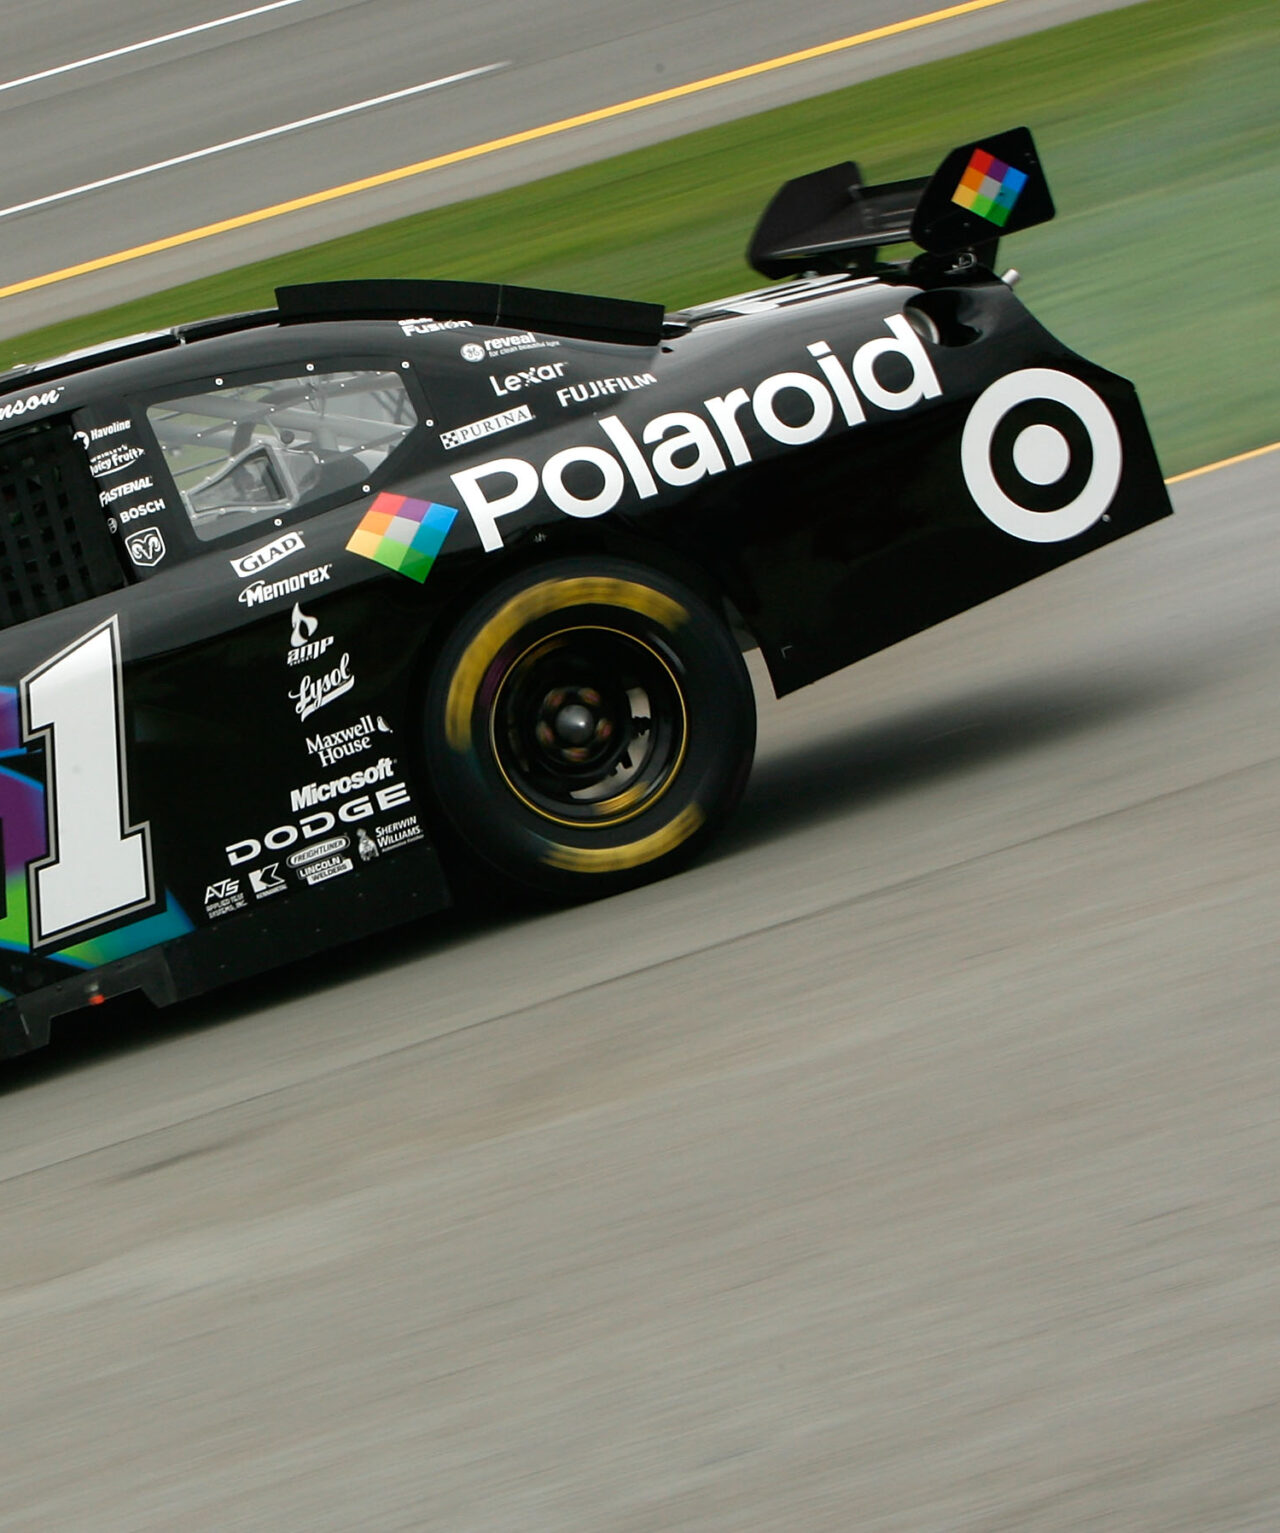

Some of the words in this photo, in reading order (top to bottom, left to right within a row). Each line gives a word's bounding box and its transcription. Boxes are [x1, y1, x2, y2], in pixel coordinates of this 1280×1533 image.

[484, 332, 537, 351] reveal
[489, 362, 566, 397] Lexar
[556, 372, 657, 407] FUJIFILM
[90, 419, 131, 441] Havoline
[450, 313, 943, 554] Polaroid
[458, 407, 531, 441] PURINA
[120, 498, 166, 524] BOSCH
[239, 534, 299, 573] GLAD
[239, 565, 331, 607] Memorex
[288, 653, 351, 714] Lysol
[306, 715, 376, 755] Maxwell
[319, 736, 372, 768] House
[291, 758, 395, 812] Microsoft
[225, 782, 411, 866] DODGE
[299, 855, 341, 878] LINCOLN
